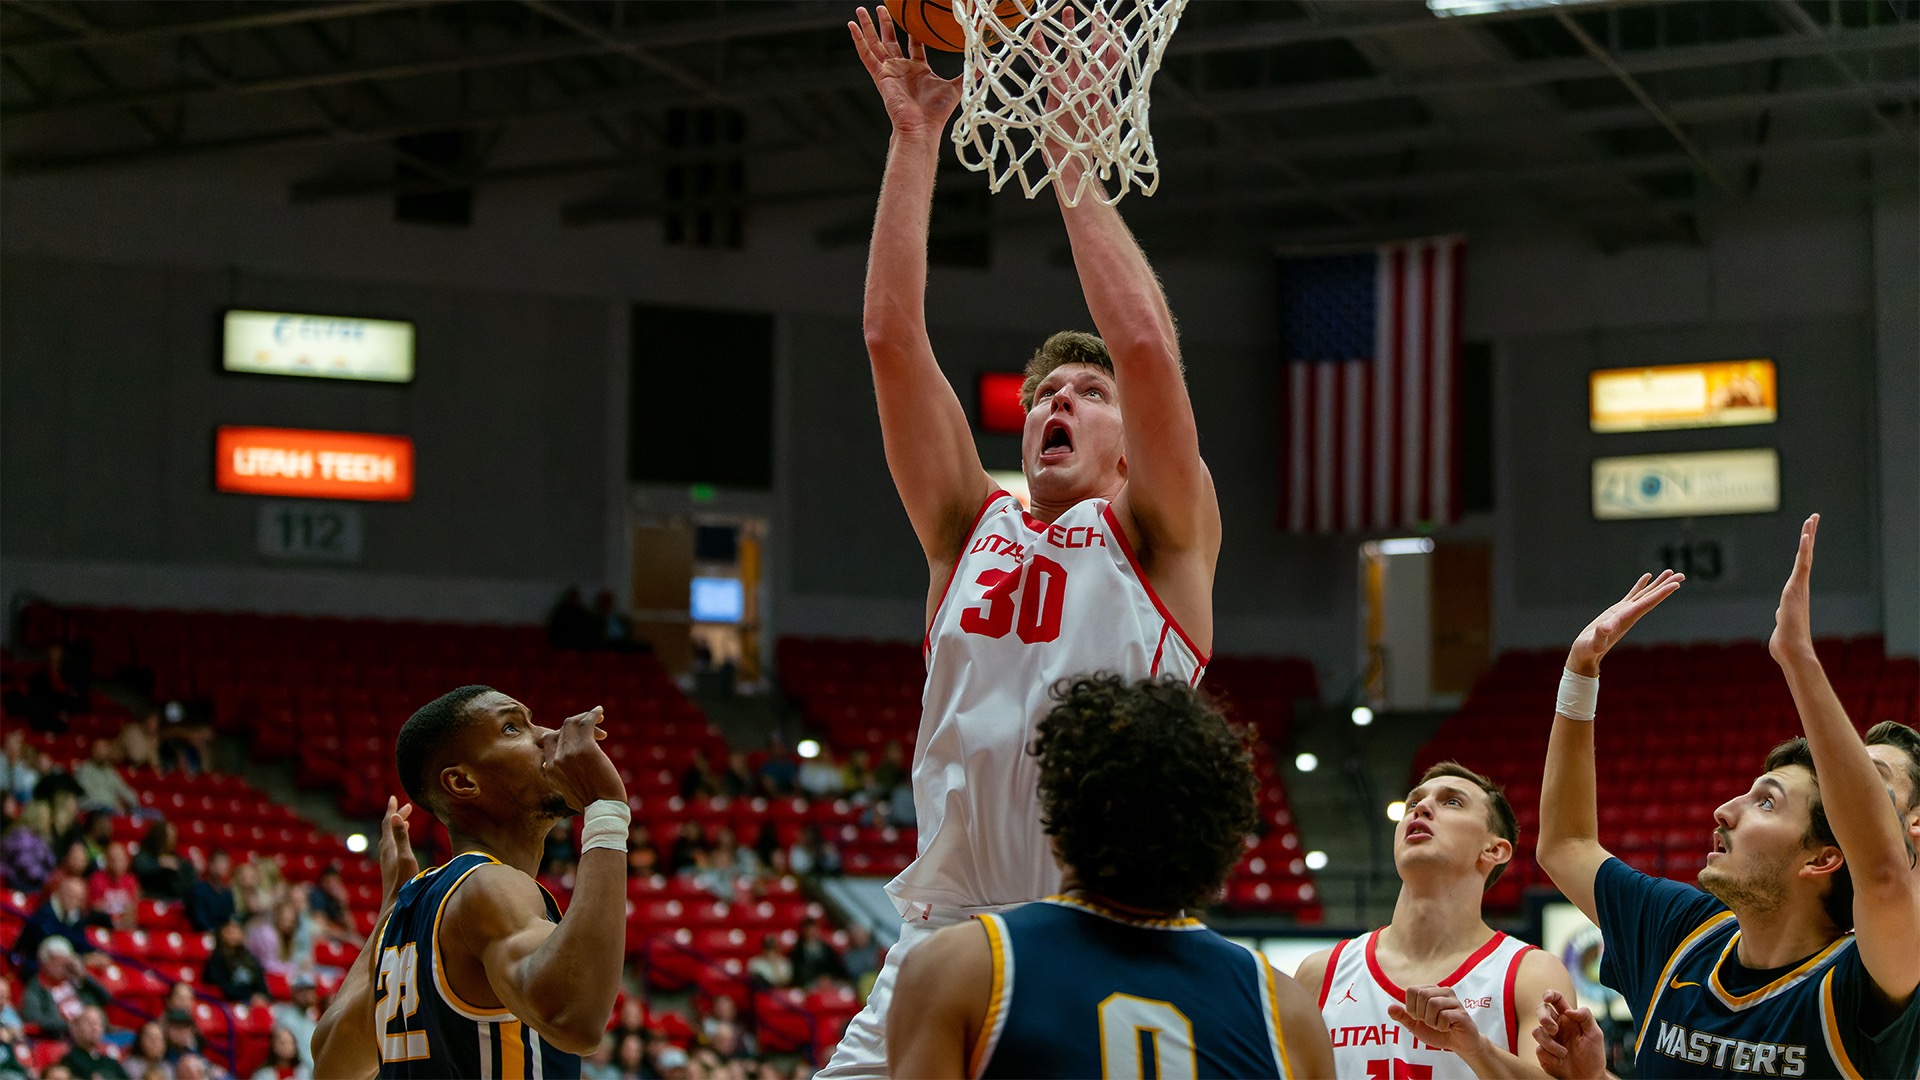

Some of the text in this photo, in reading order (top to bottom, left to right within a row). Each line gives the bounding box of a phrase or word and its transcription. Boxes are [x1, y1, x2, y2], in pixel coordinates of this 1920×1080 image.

[233, 446, 396, 484] UTAH TECH
[277, 510, 344, 549] 112
[1046, 524, 1107, 549] ECH
[959, 554, 1068, 645] 30
[1330, 1023, 1400, 1048] UTAH
[1655, 1018, 1808, 1078] MASTER'S
